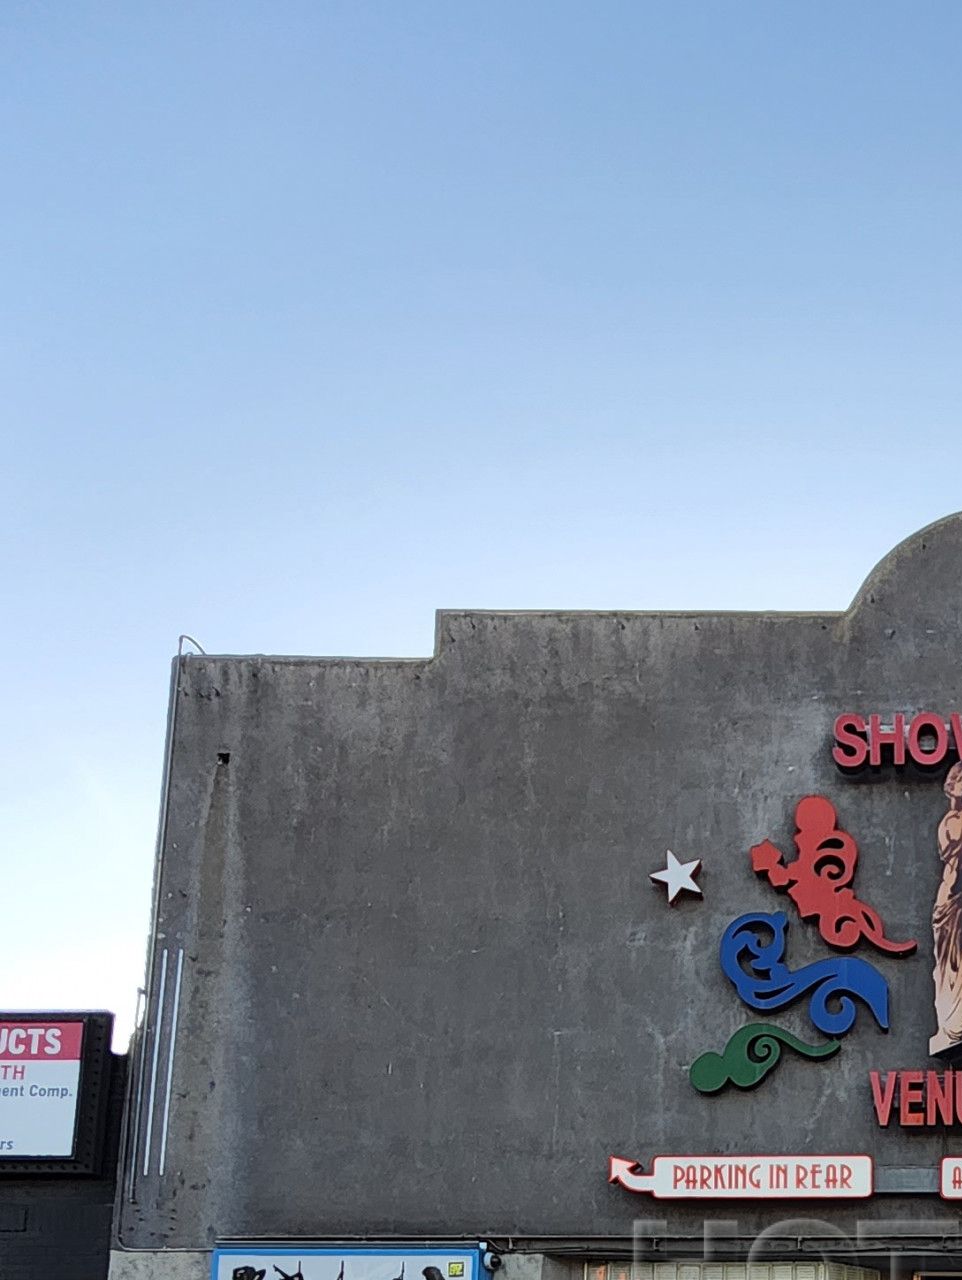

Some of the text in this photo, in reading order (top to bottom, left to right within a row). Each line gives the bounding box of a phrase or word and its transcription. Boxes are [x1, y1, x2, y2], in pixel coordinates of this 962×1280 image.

[0, 1084, 73, 1099] ent Comp.
[672, 1164, 853, 1190] PARKING IN REAR
